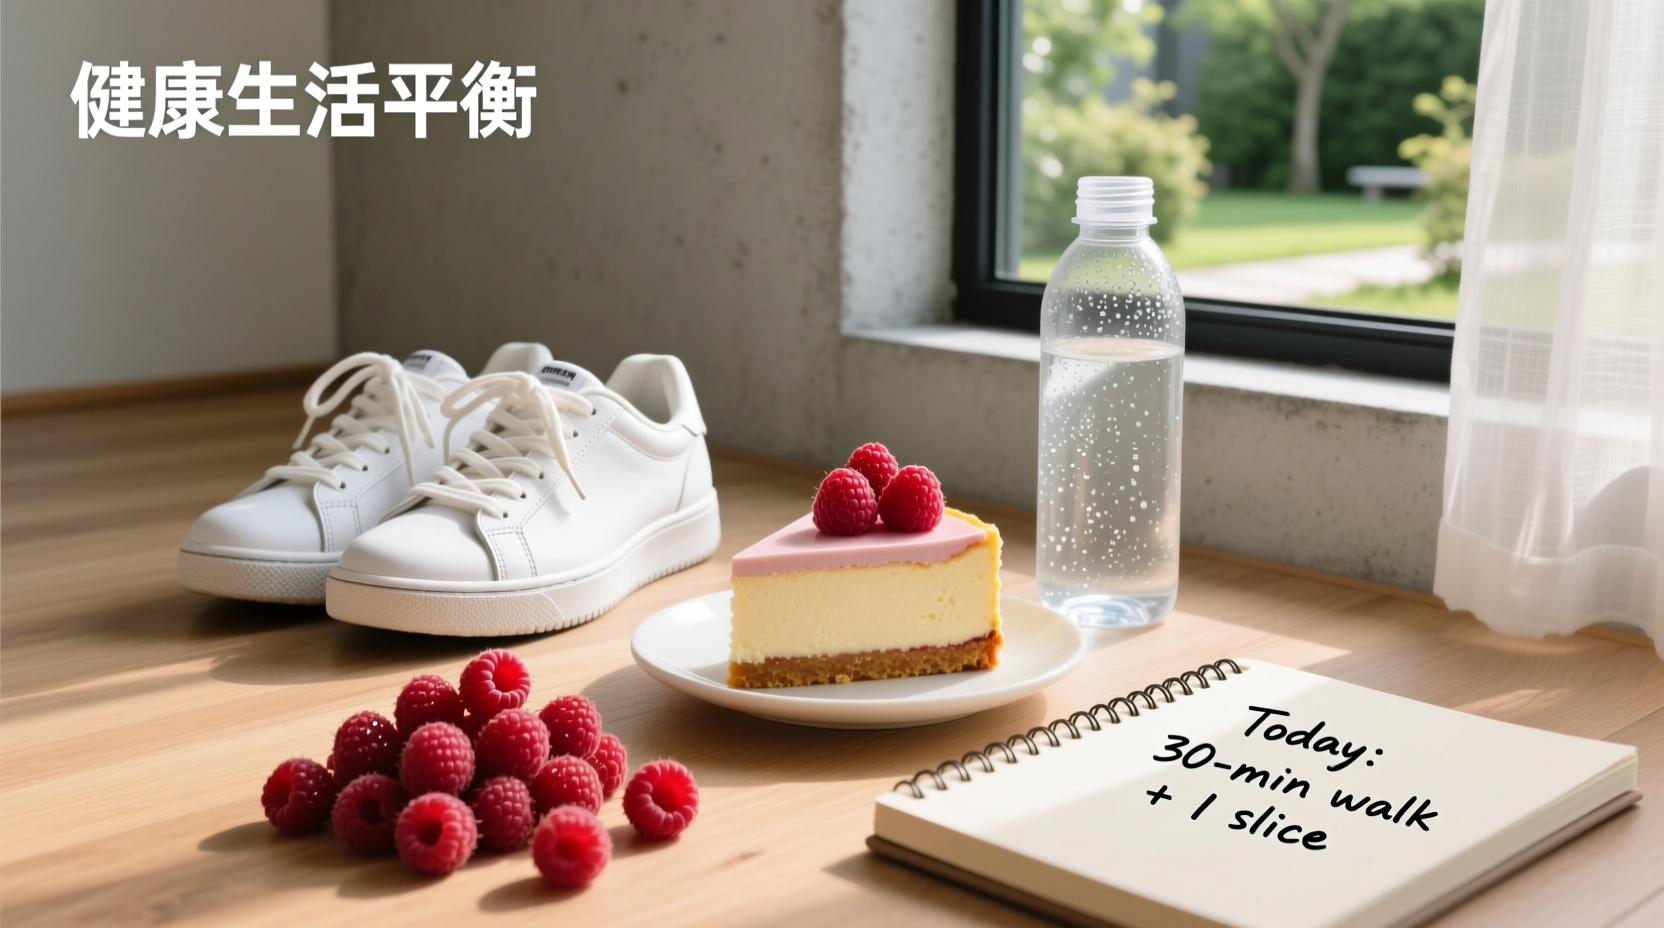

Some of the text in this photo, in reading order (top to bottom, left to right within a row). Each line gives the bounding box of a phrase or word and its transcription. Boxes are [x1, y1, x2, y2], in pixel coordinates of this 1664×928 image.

[1244, 705, 1384, 772] Today:
[1152, 734, 1439, 832] 30-min walk
[1146, 784, 1172, 806] +
[1227, 805, 1327, 851] slice
